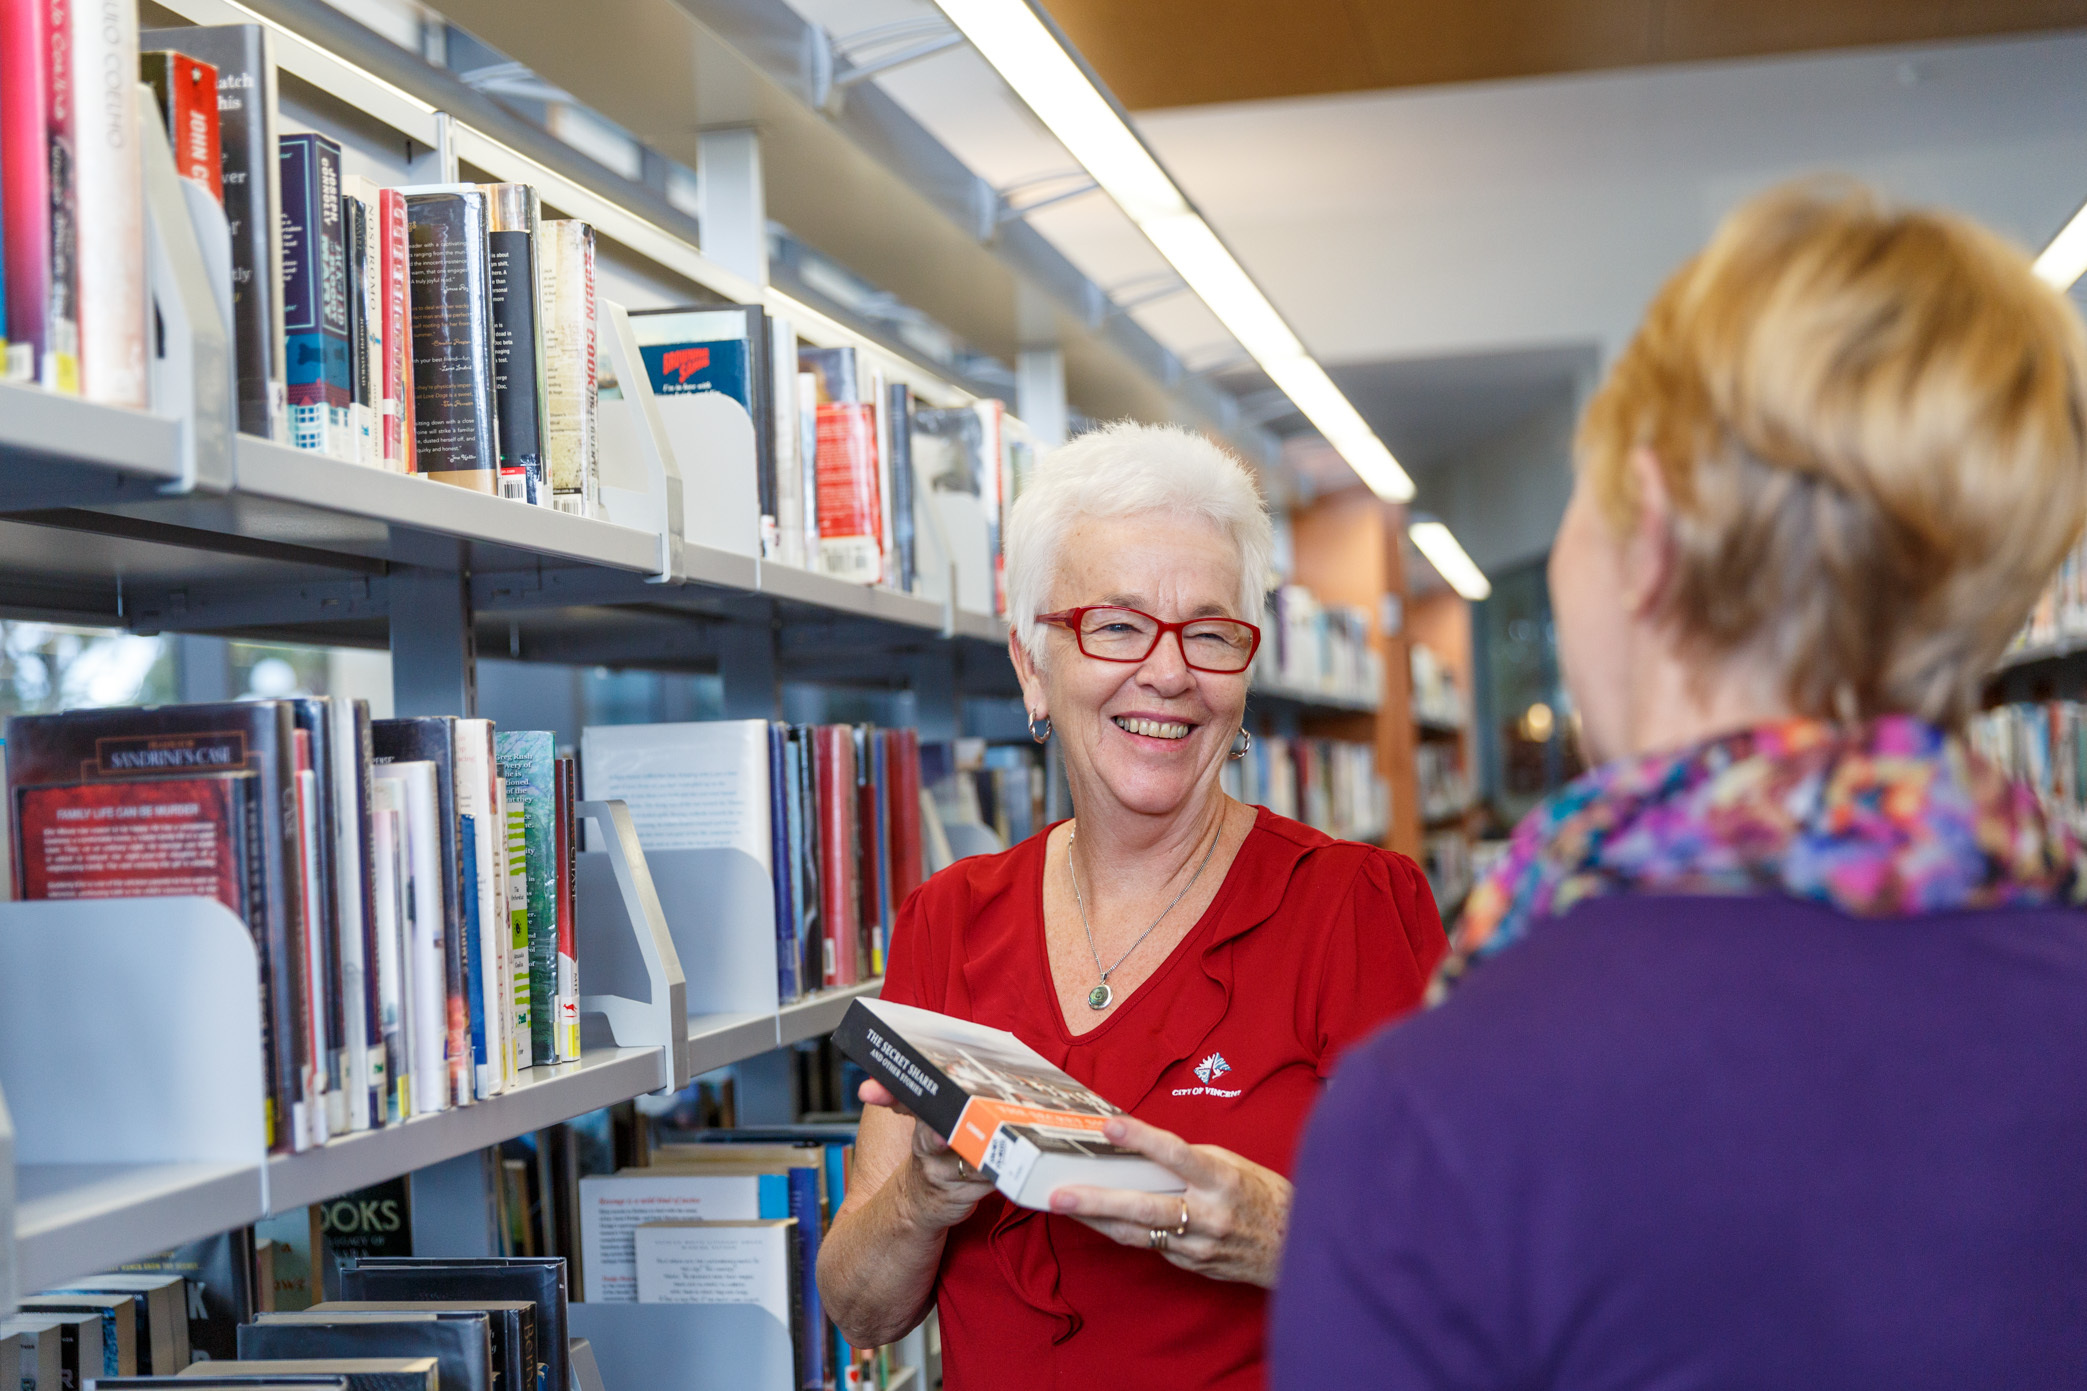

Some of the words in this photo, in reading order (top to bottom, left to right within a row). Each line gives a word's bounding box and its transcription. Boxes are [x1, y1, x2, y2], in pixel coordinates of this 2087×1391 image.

[104, 53, 123, 149] COELHO
[217, 73, 253, 89] atch
[217, 96, 241, 110] his
[189, 109, 208, 161] JOHN
[222, 172, 247, 184] ver
[321, 157, 332, 226] CONNOLLY
[329, 167, 339, 224] JOSEPH
[232, 266, 253, 283] tly
[368, 204, 376, 311] NOSTROMO
[584, 252, 595, 321] ROBIN
[586, 327, 596, 388] COOK
[111, 748, 194, 768] SANDRINE'S
[196, 746, 230, 763] CASE
[57, 808, 91, 820] FAMILY
[93, 807, 114, 819] LIFE
[115, 806, 137, 818] CAN
[138, 805, 152, 817] BE
[154, 803, 198, 816] MURDER
[516, 796, 533, 804] they
[866, 1028, 884, 1048] THE
[881, 1041, 911, 1070] SECRET
[907, 1064, 939, 1096] SHARER
[870, 1048, 884, 1062] AND
[882, 1058, 901, 1078] OTHER
[900, 1072, 923, 1096] STORIES
[1171, 1088, 1192, 1096] CITY
[1192, 1087, 1204, 1095] OF
[1205, 1086, 1242, 1098] VINCENT
